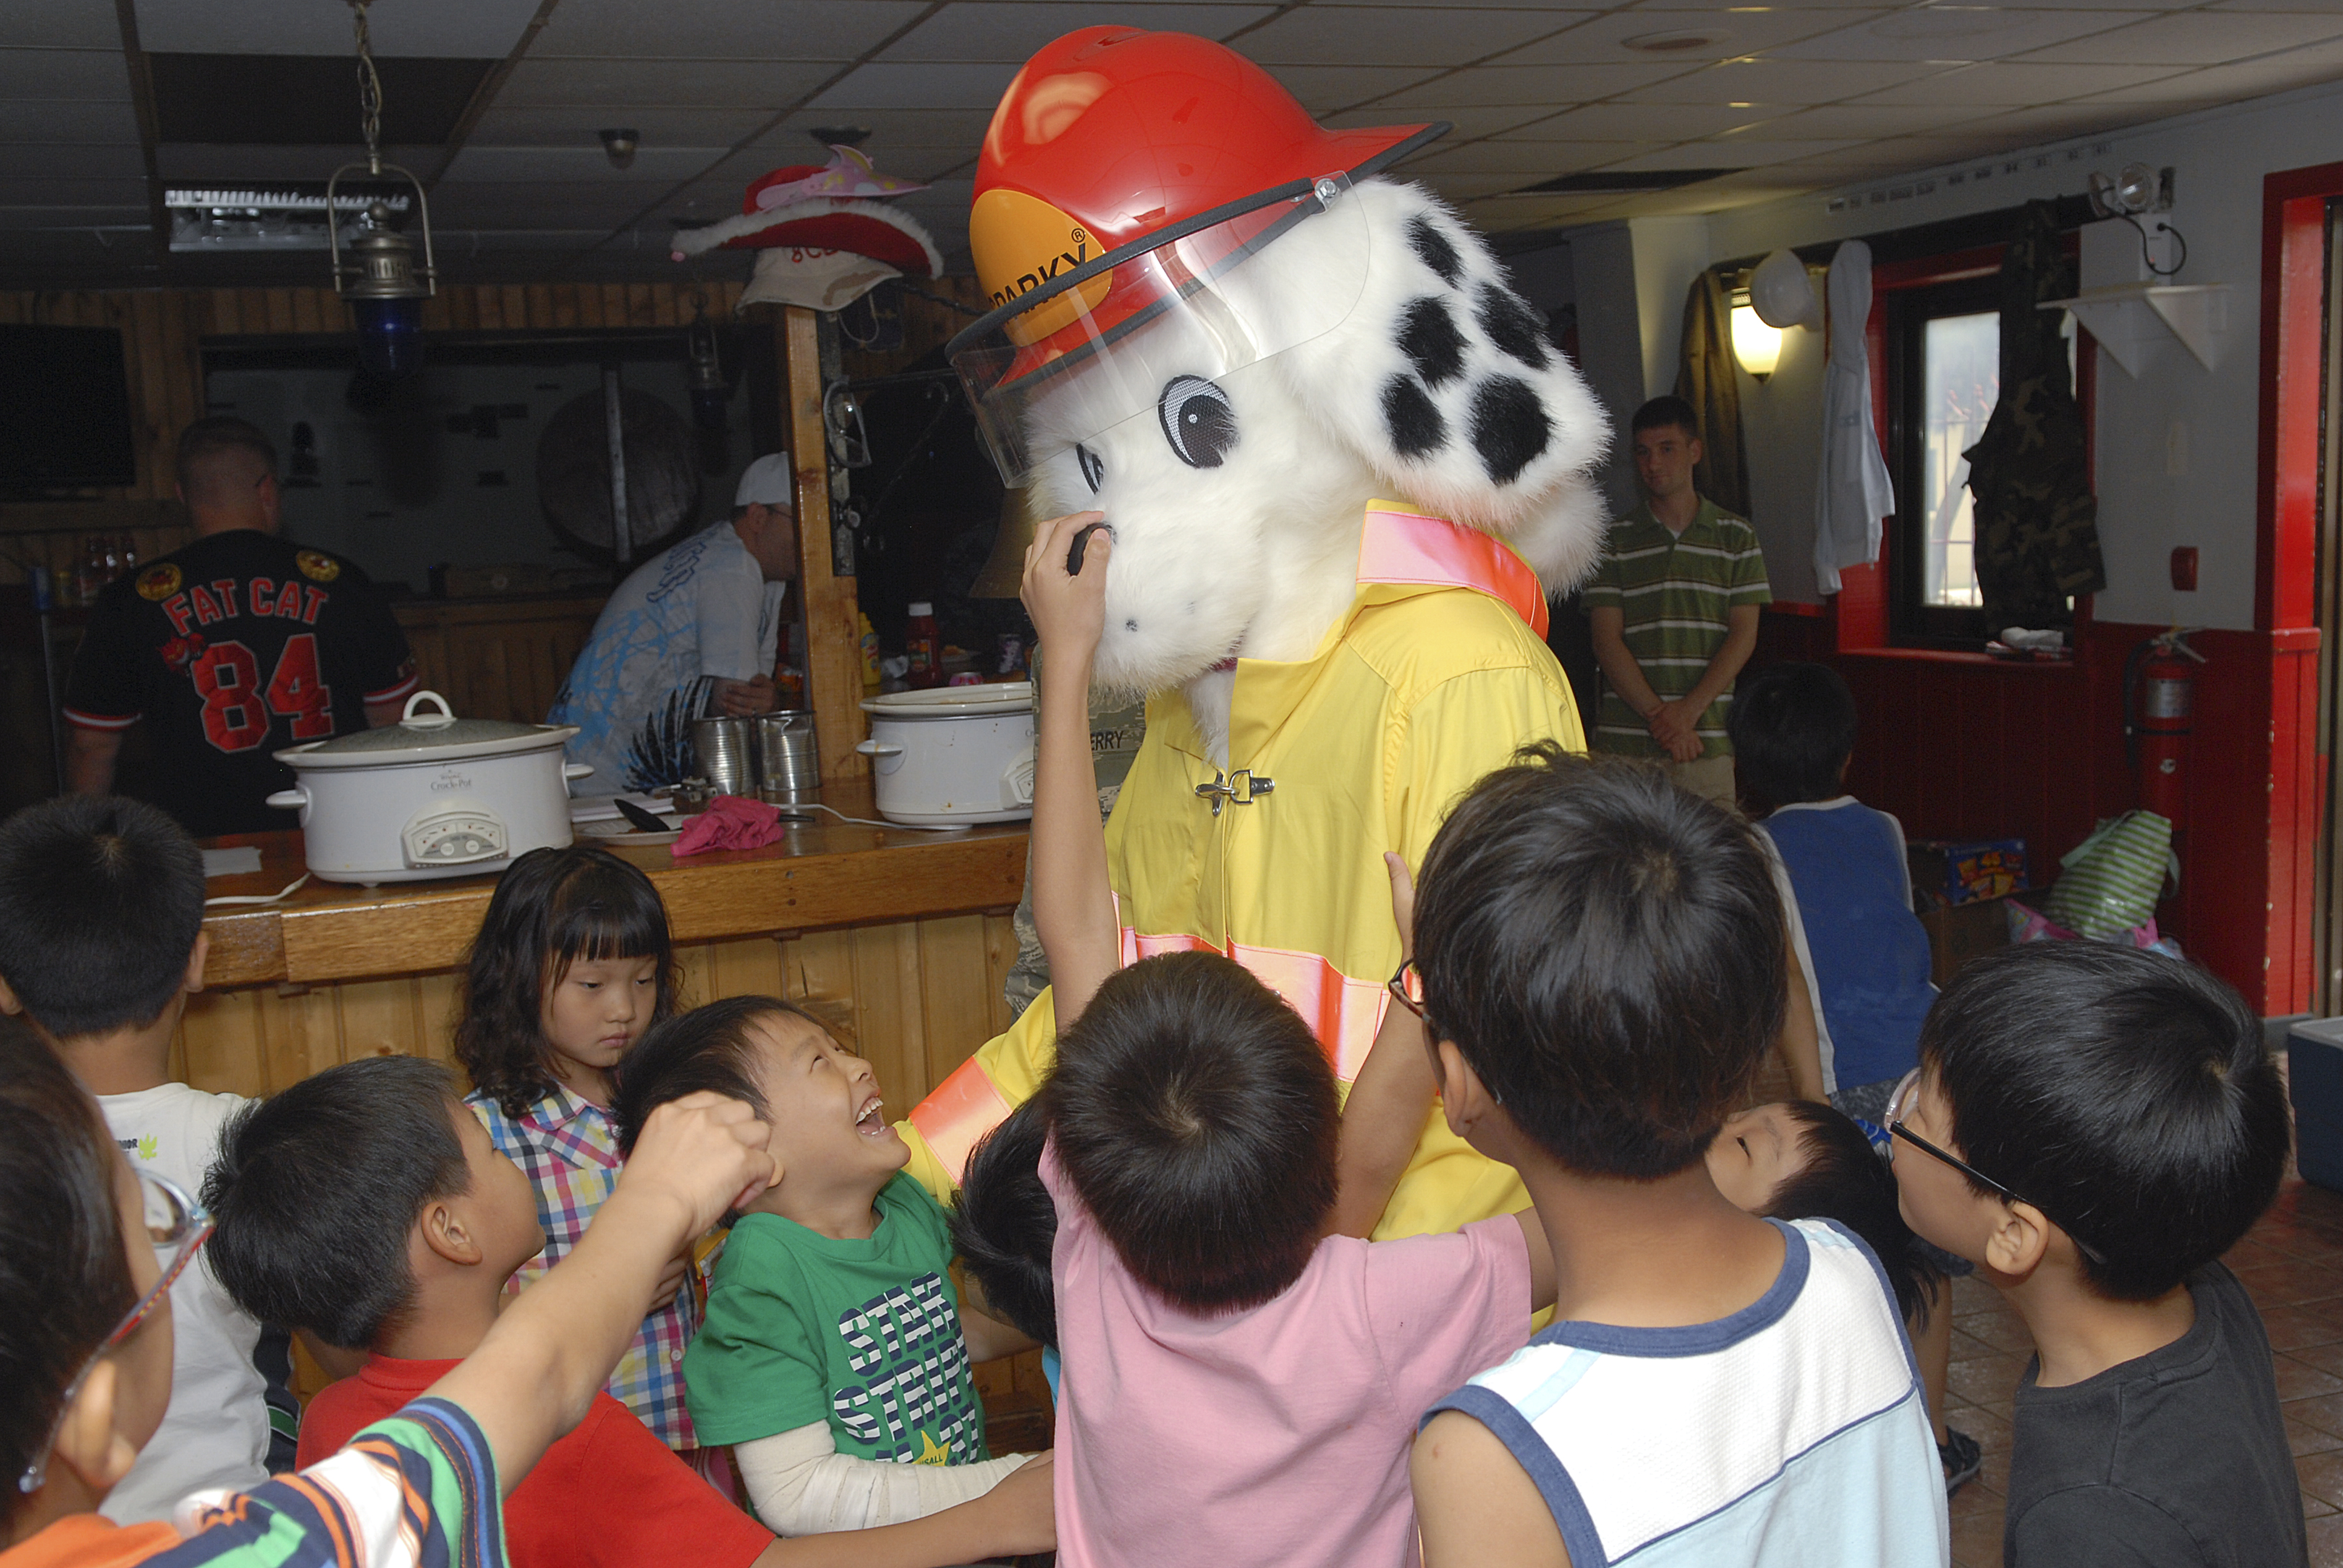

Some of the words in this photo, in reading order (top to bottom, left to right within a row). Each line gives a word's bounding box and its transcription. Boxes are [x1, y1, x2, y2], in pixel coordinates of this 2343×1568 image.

[161, 578, 238, 636] FAT
[249, 577, 329, 624] CAT
[189, 633, 335, 754] 84
[839, 1271, 955, 1377] STAR
